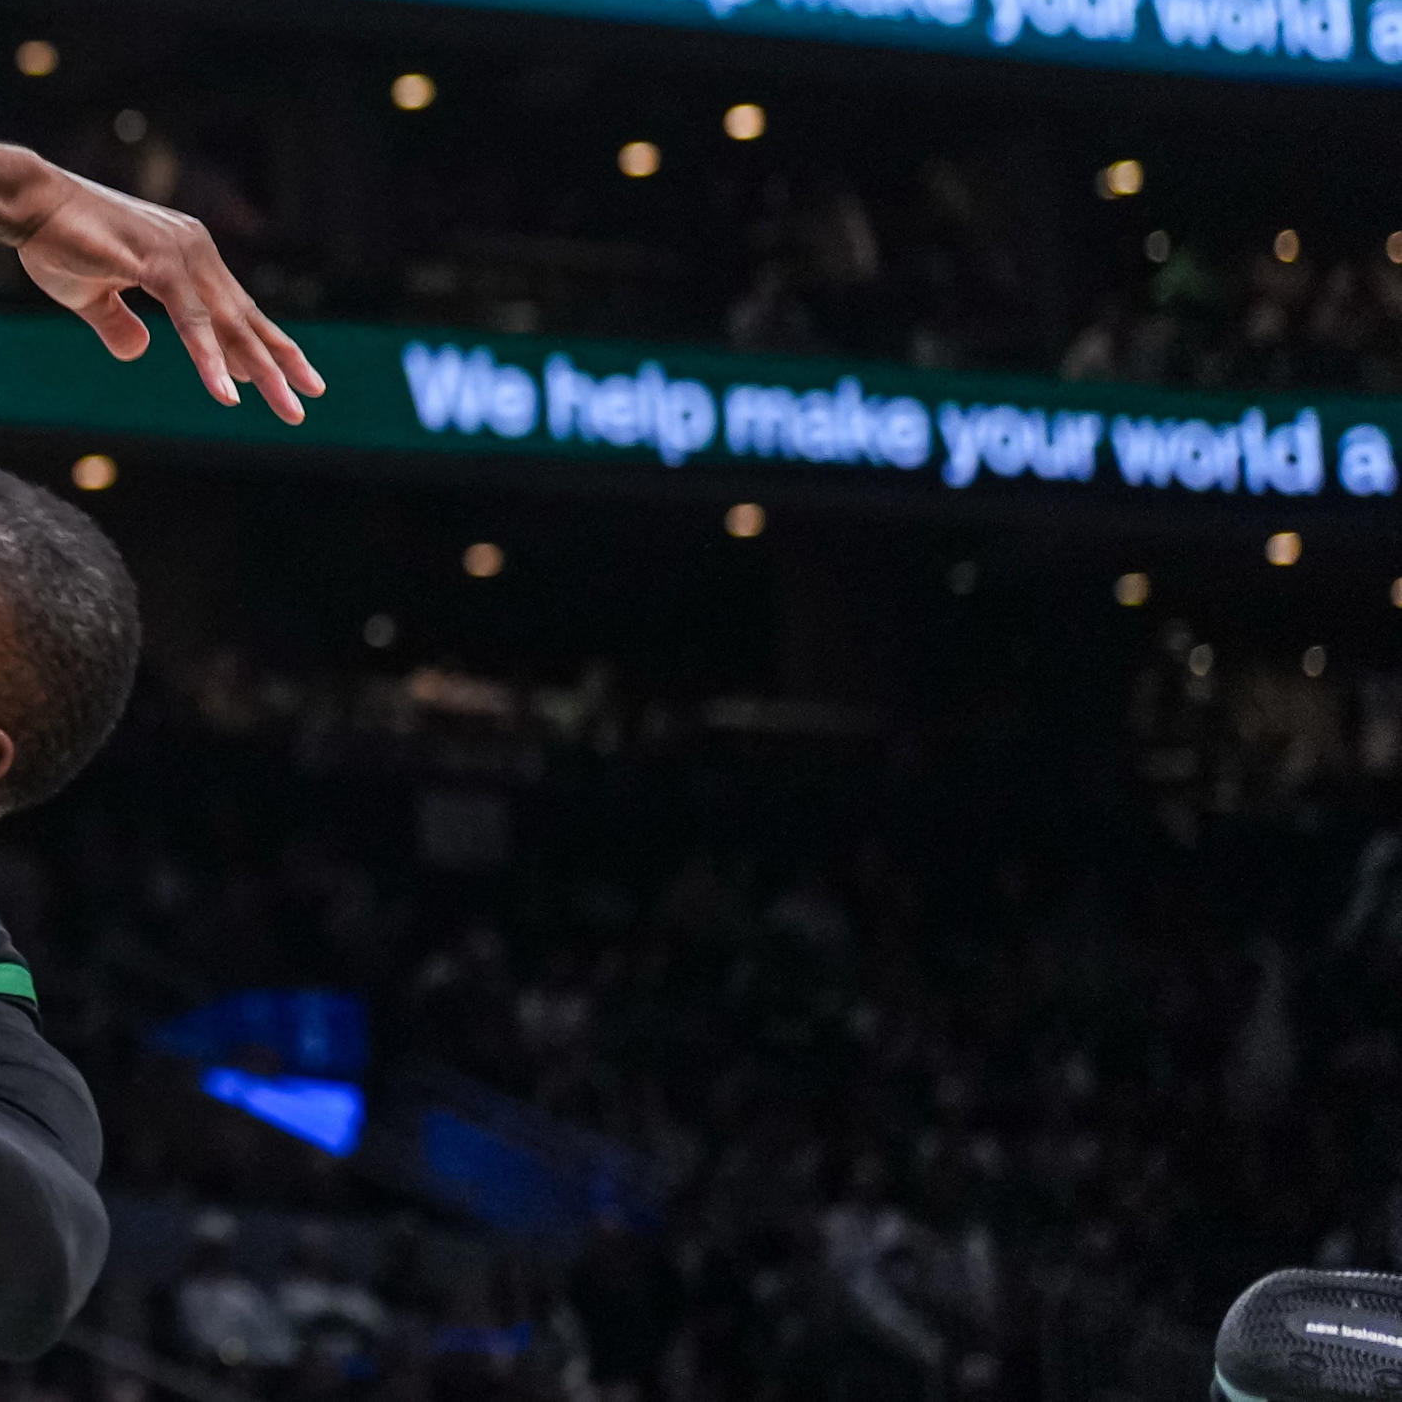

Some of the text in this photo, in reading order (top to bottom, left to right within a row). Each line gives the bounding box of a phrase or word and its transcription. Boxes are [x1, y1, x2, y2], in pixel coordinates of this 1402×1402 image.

[403, 344, 1397, 496] We help make your world a
[1306, 1323, 1339, 1335] new
